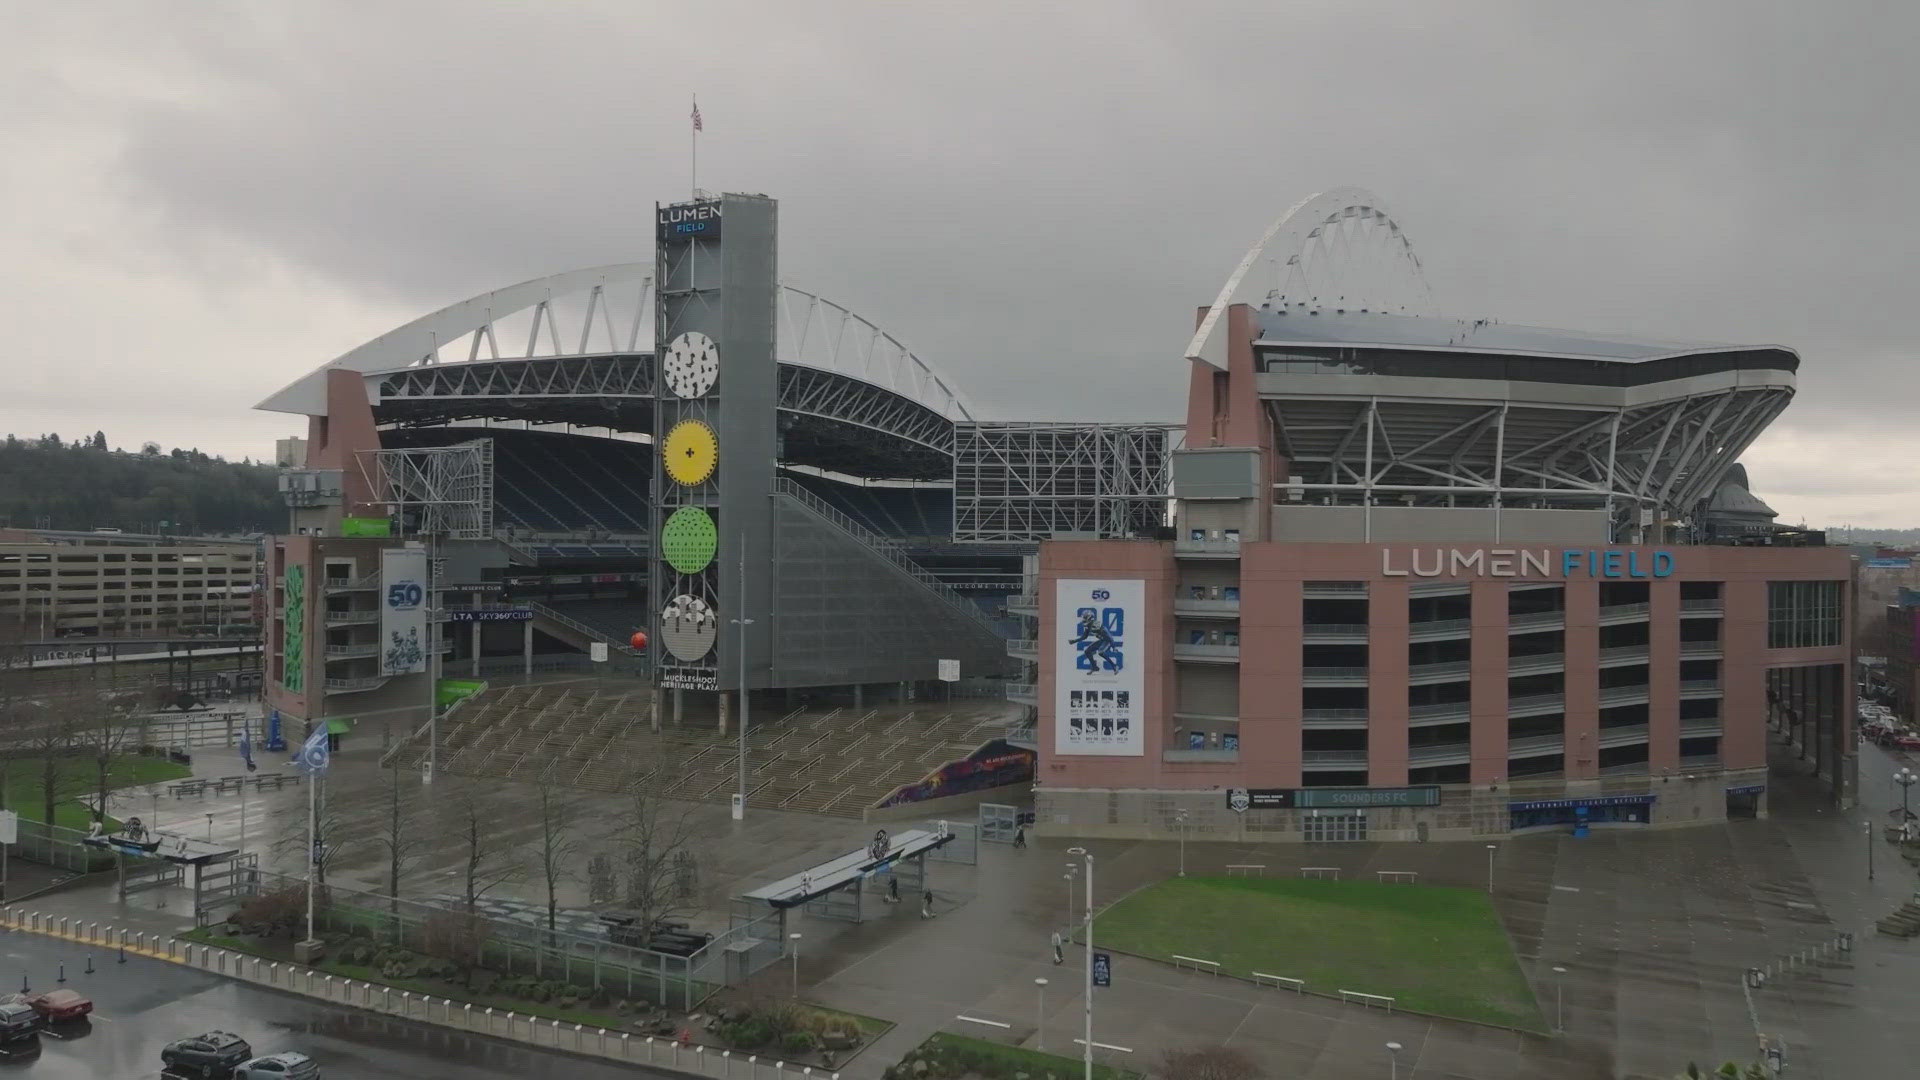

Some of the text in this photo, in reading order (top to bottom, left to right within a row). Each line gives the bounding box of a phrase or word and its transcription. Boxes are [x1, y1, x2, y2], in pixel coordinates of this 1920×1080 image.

[660, 205, 721, 224] LUMEN
[676, 222, 705, 232] FIELD
[1382, 548, 1675, 578] LUMEN FIELD
[388, 583, 422, 607] 50
[1091, 590, 1110, 600] 50
[512, 611, 533, 619] CLUB
[664, 675, 717, 684] MUCKLESHOOT
[660, 681, 695, 690] HERITAGE
[1332, 791, 1407, 803] SOUNDERS FC
